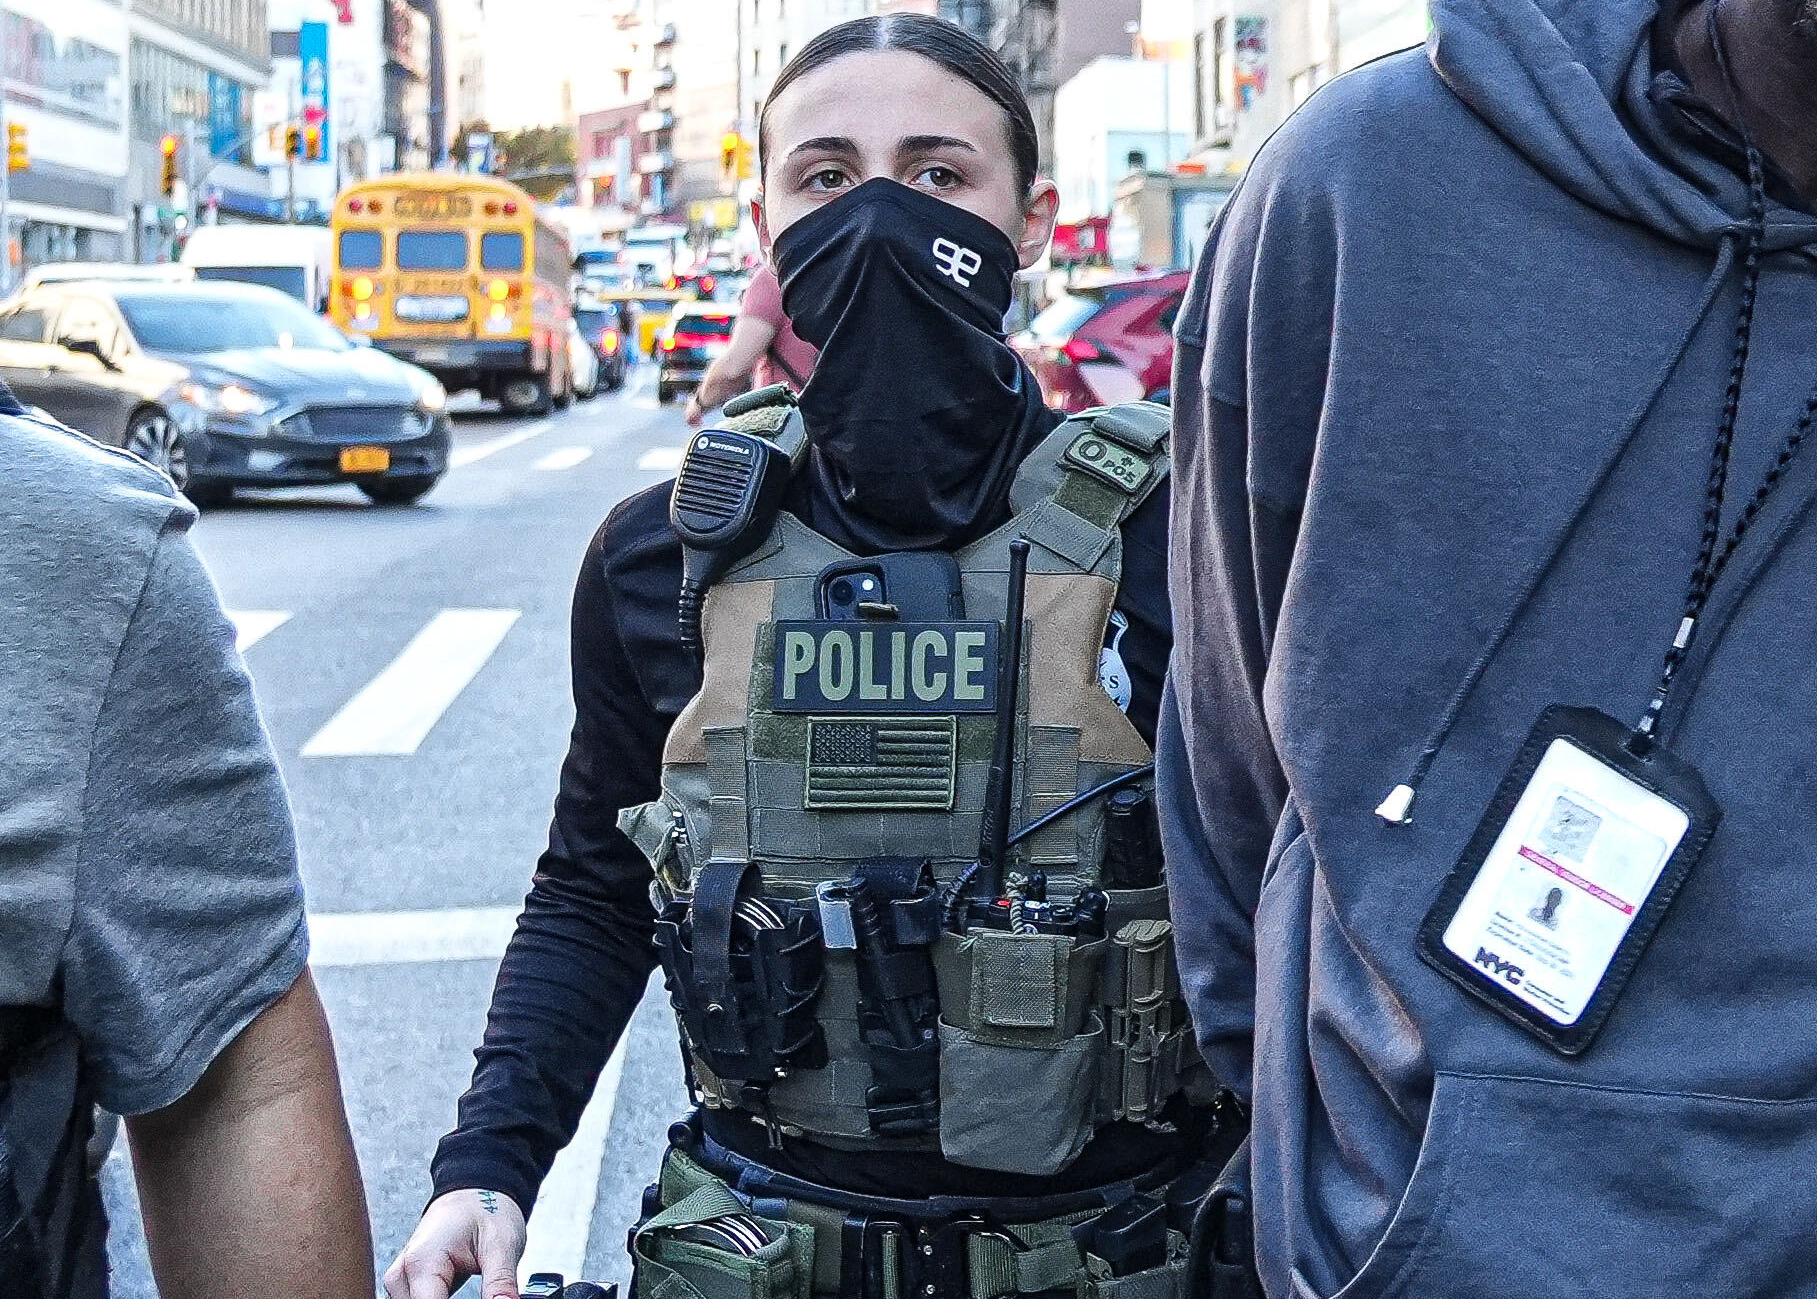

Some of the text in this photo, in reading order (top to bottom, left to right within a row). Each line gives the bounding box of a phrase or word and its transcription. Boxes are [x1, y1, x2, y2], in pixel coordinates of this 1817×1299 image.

[1101, 457, 1136, 485] POS
[782, 630, 987, 701] POLICE
[1473, 946, 1526, 986] NYC
